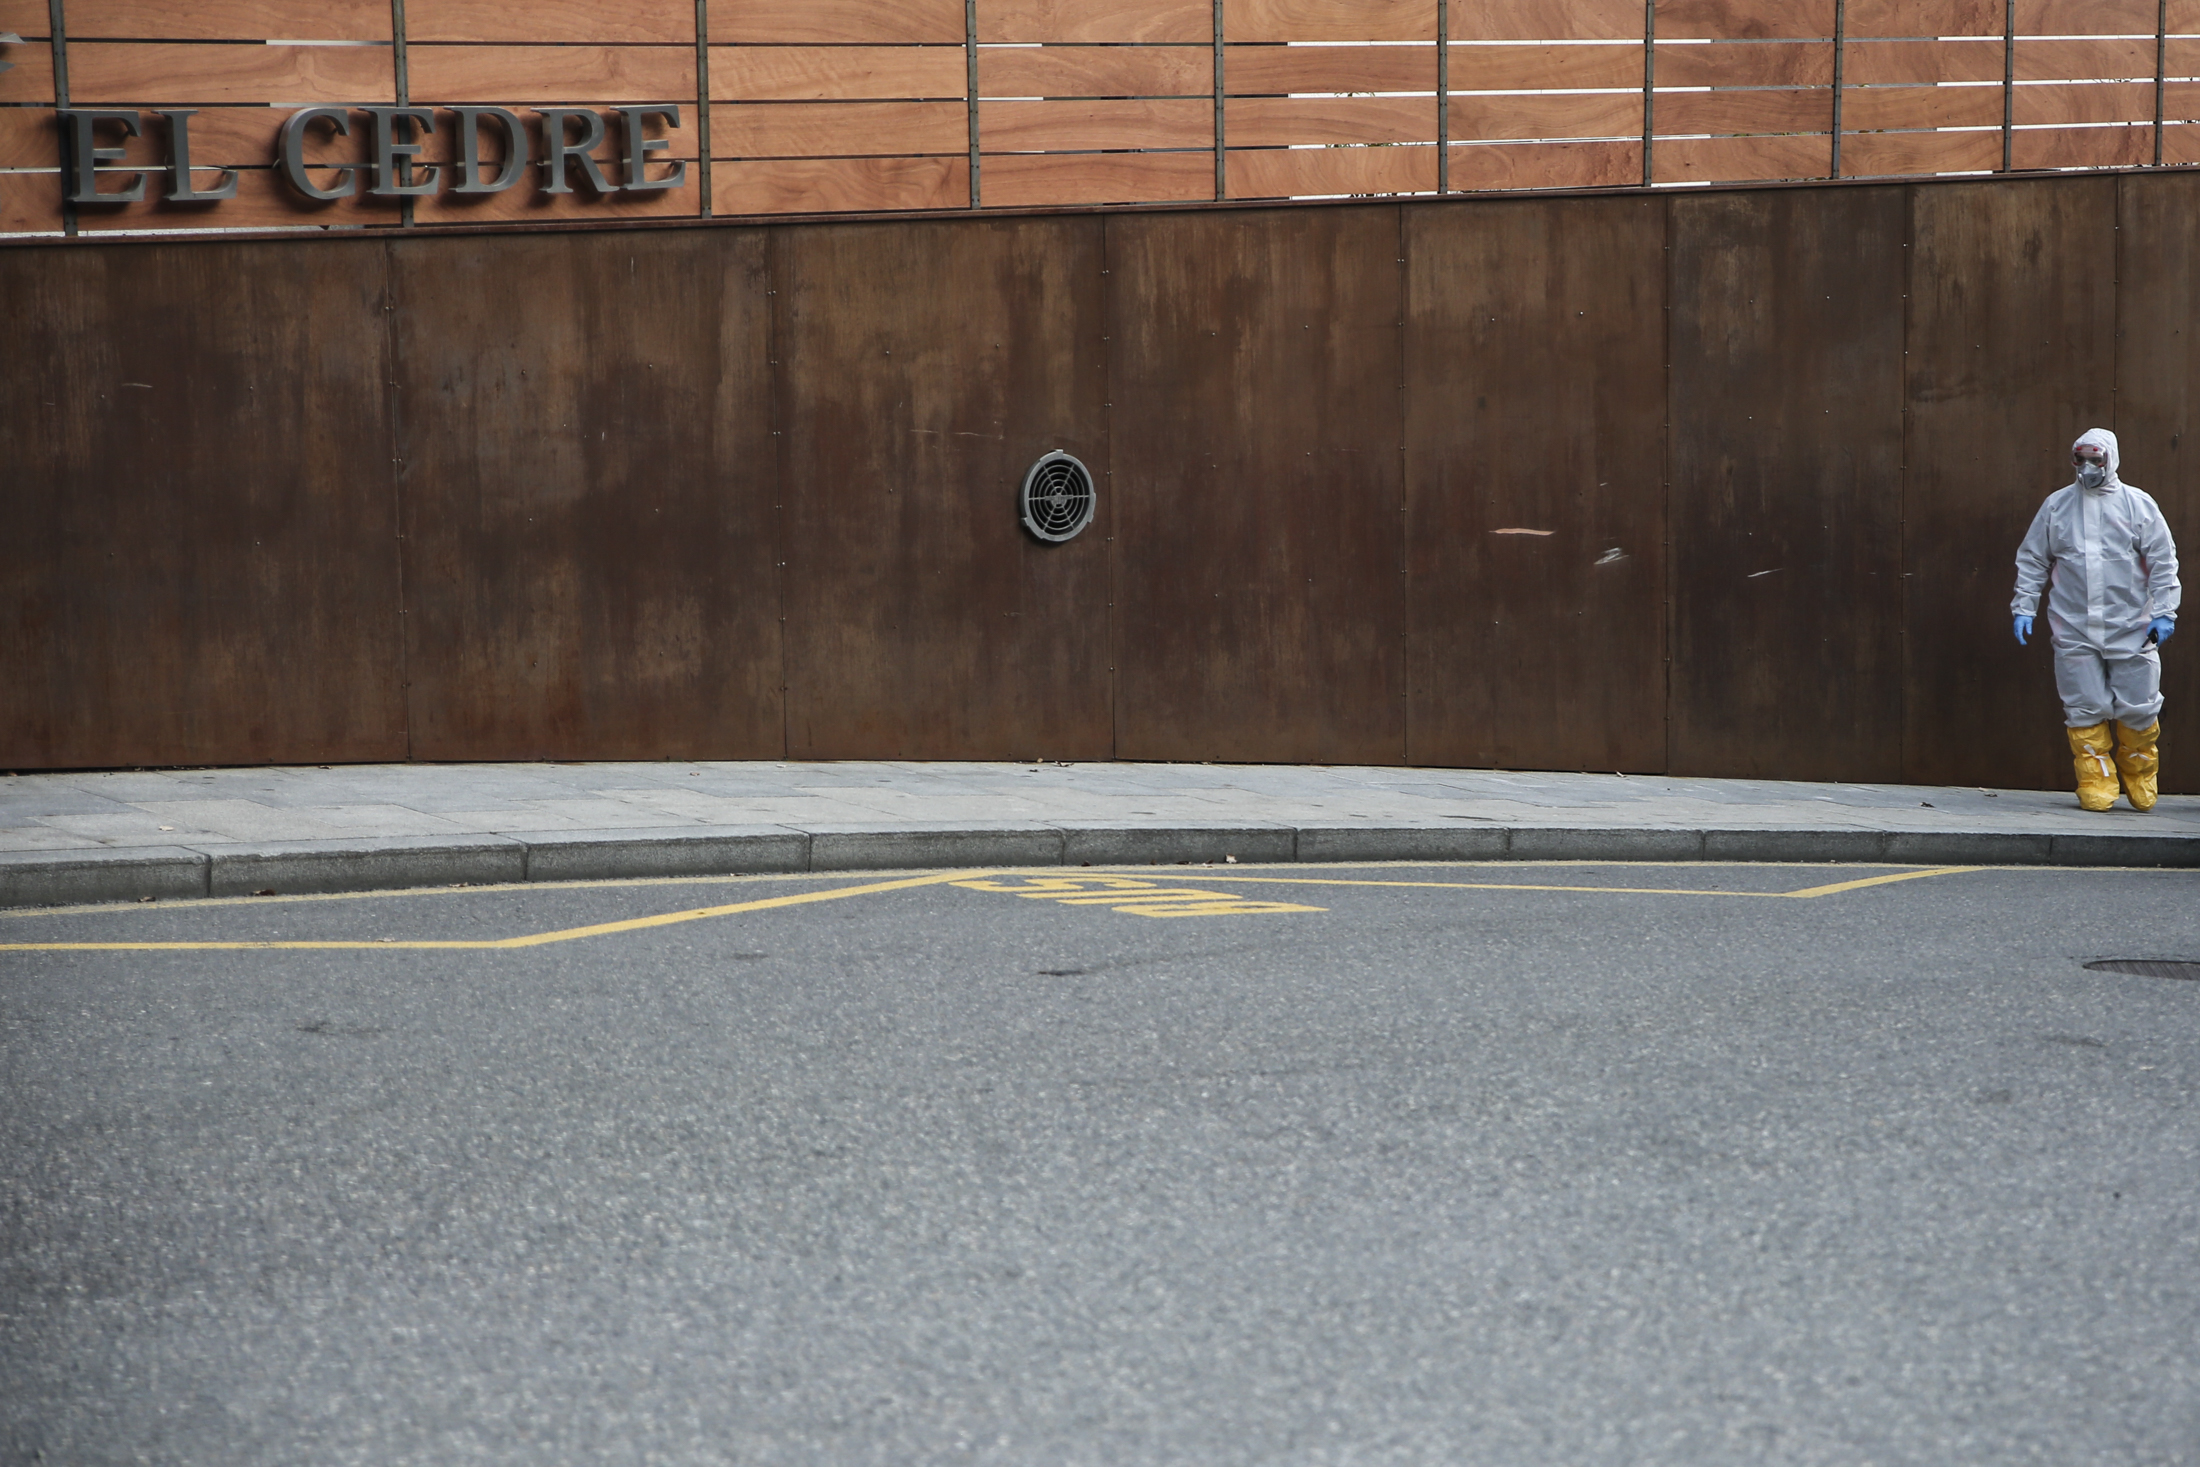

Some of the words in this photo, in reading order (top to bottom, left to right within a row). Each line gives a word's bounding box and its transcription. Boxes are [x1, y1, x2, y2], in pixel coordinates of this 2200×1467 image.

[59, 107, 238, 202] EL
[279, 104, 686, 200] CEDRE
[948, 877, 1330, 917] BUS
